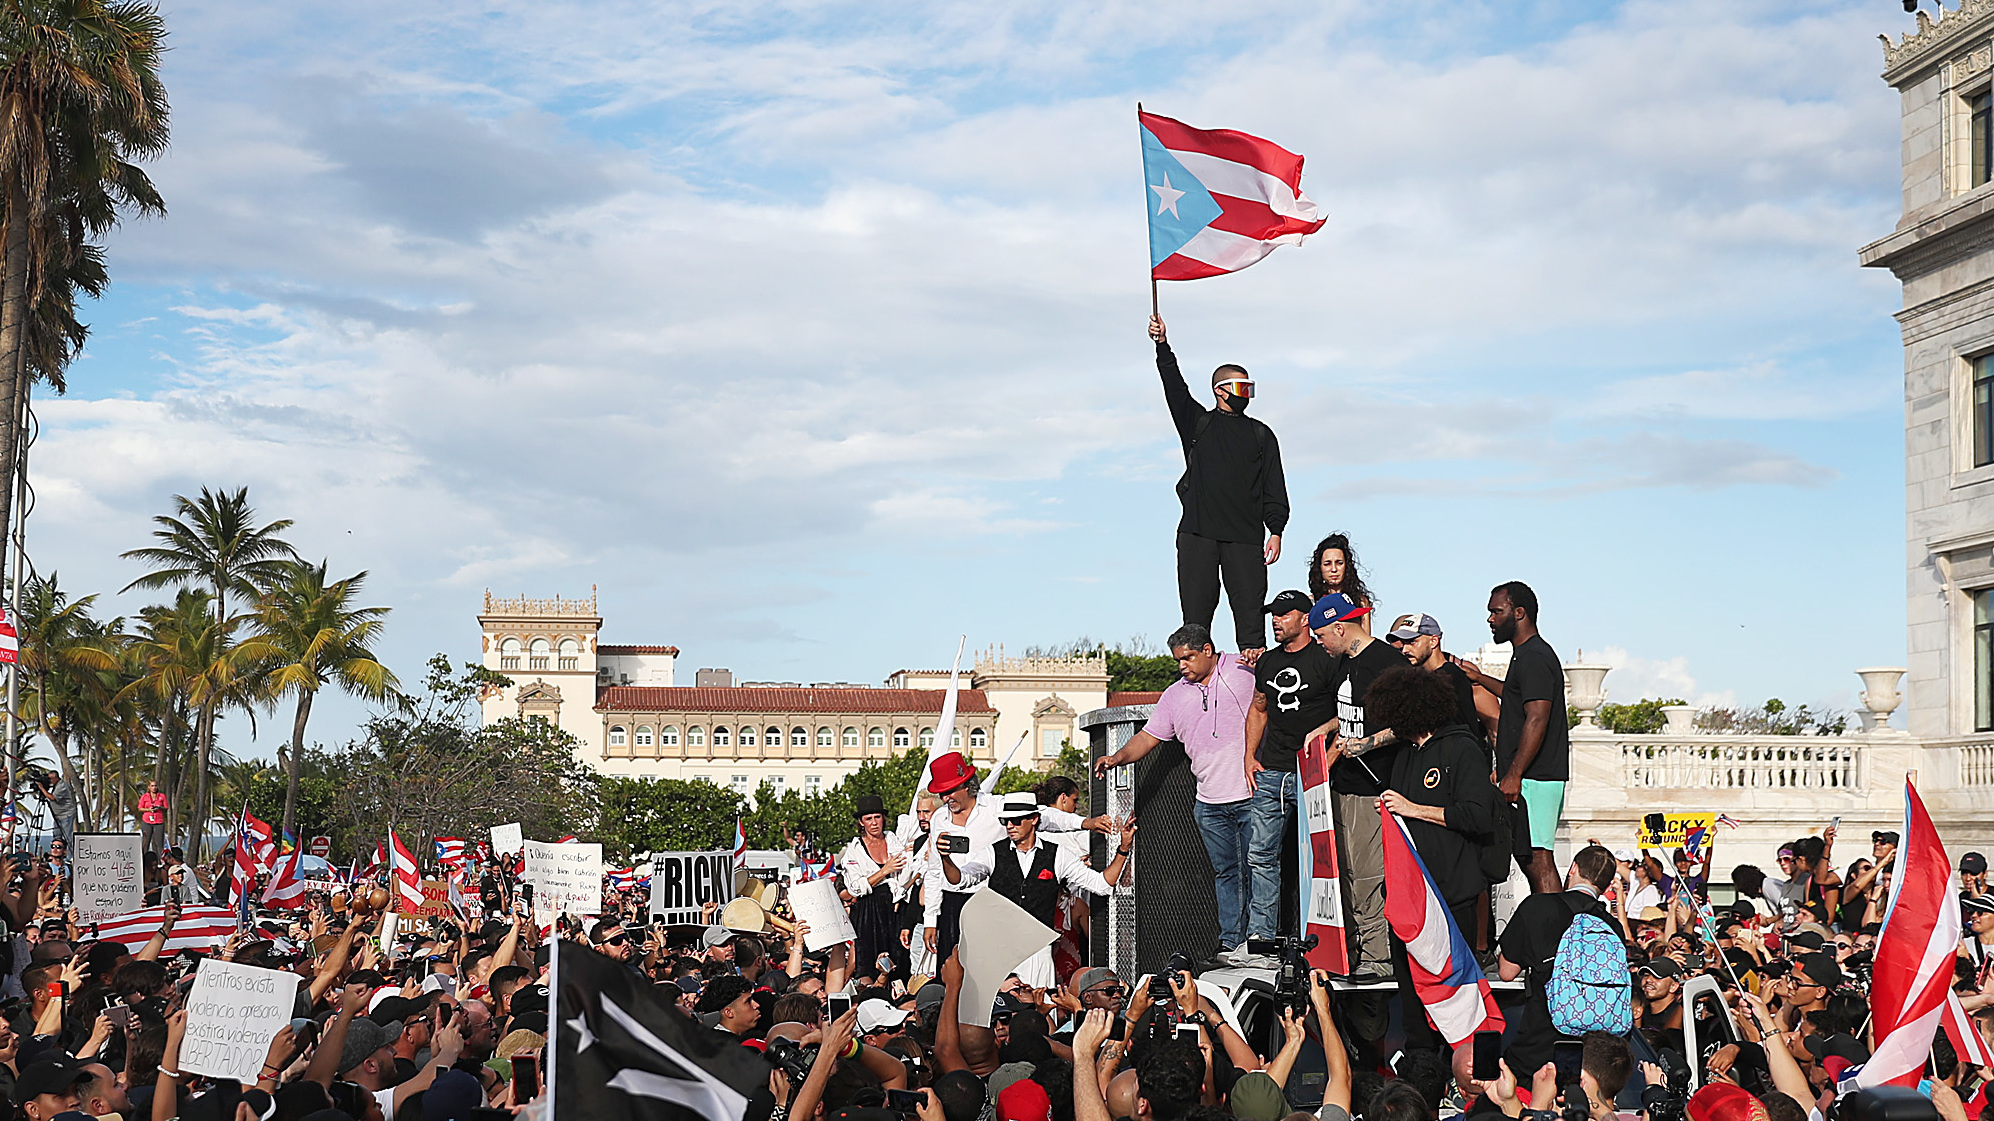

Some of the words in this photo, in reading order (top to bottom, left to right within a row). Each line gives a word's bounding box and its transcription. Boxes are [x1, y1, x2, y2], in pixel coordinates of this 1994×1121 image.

[78, 839, 111, 860] Estamos
[115, 847, 132, 861] aquí
[561, 852, 592, 862] escribir
[77, 865, 90, 879] por
[94, 864, 106, 876] los
[81, 882, 96, 895] que
[654, 856, 733, 908] #RICKY
[415, 906, 455, 917] EEMPLAZAR
[398, 918, 412, 931] MI
[200, 963, 242, 990] Mientras
[245, 974, 275, 994] exista
[189, 997, 235, 1018] violencia
[187, 1021, 226, 1039] existirá
[228, 1022, 270, 1044] violencia
